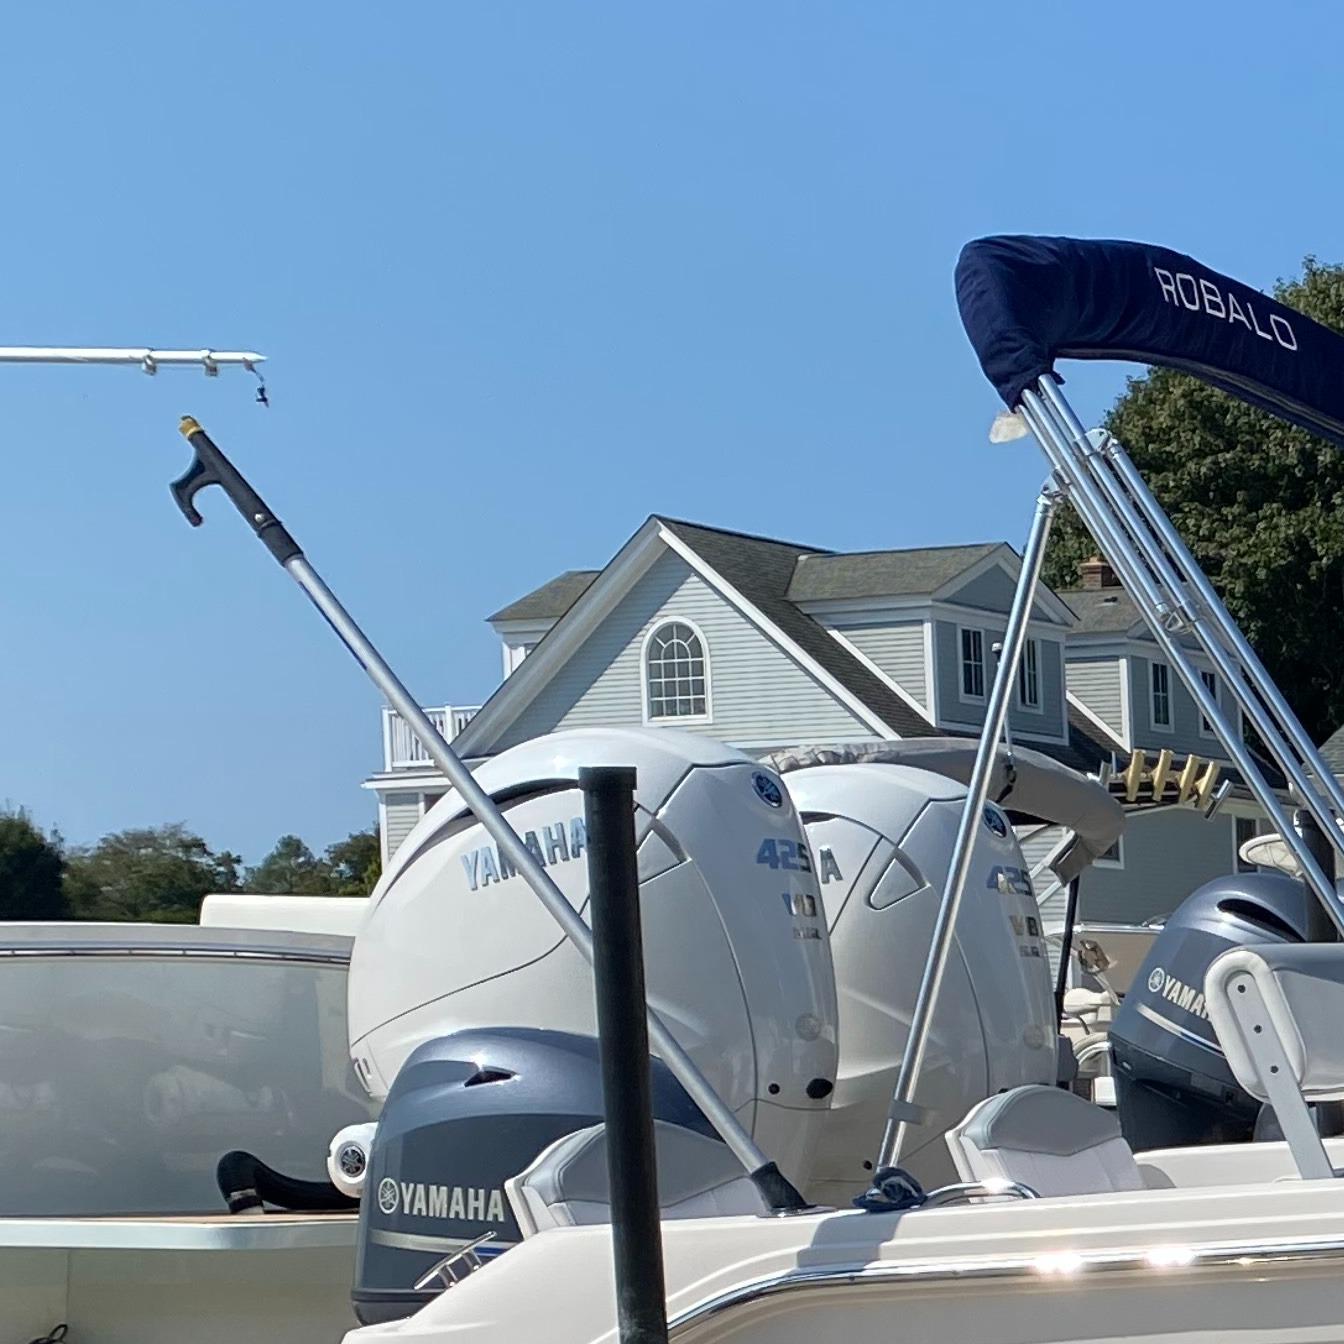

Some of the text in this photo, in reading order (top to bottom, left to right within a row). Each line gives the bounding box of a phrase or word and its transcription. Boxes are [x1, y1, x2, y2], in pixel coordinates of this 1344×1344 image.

[1154, 267, 1297, 351] ROBALO
[756, 838, 812, 873] 425
[401, 1182, 505, 1222] YAMAHA
